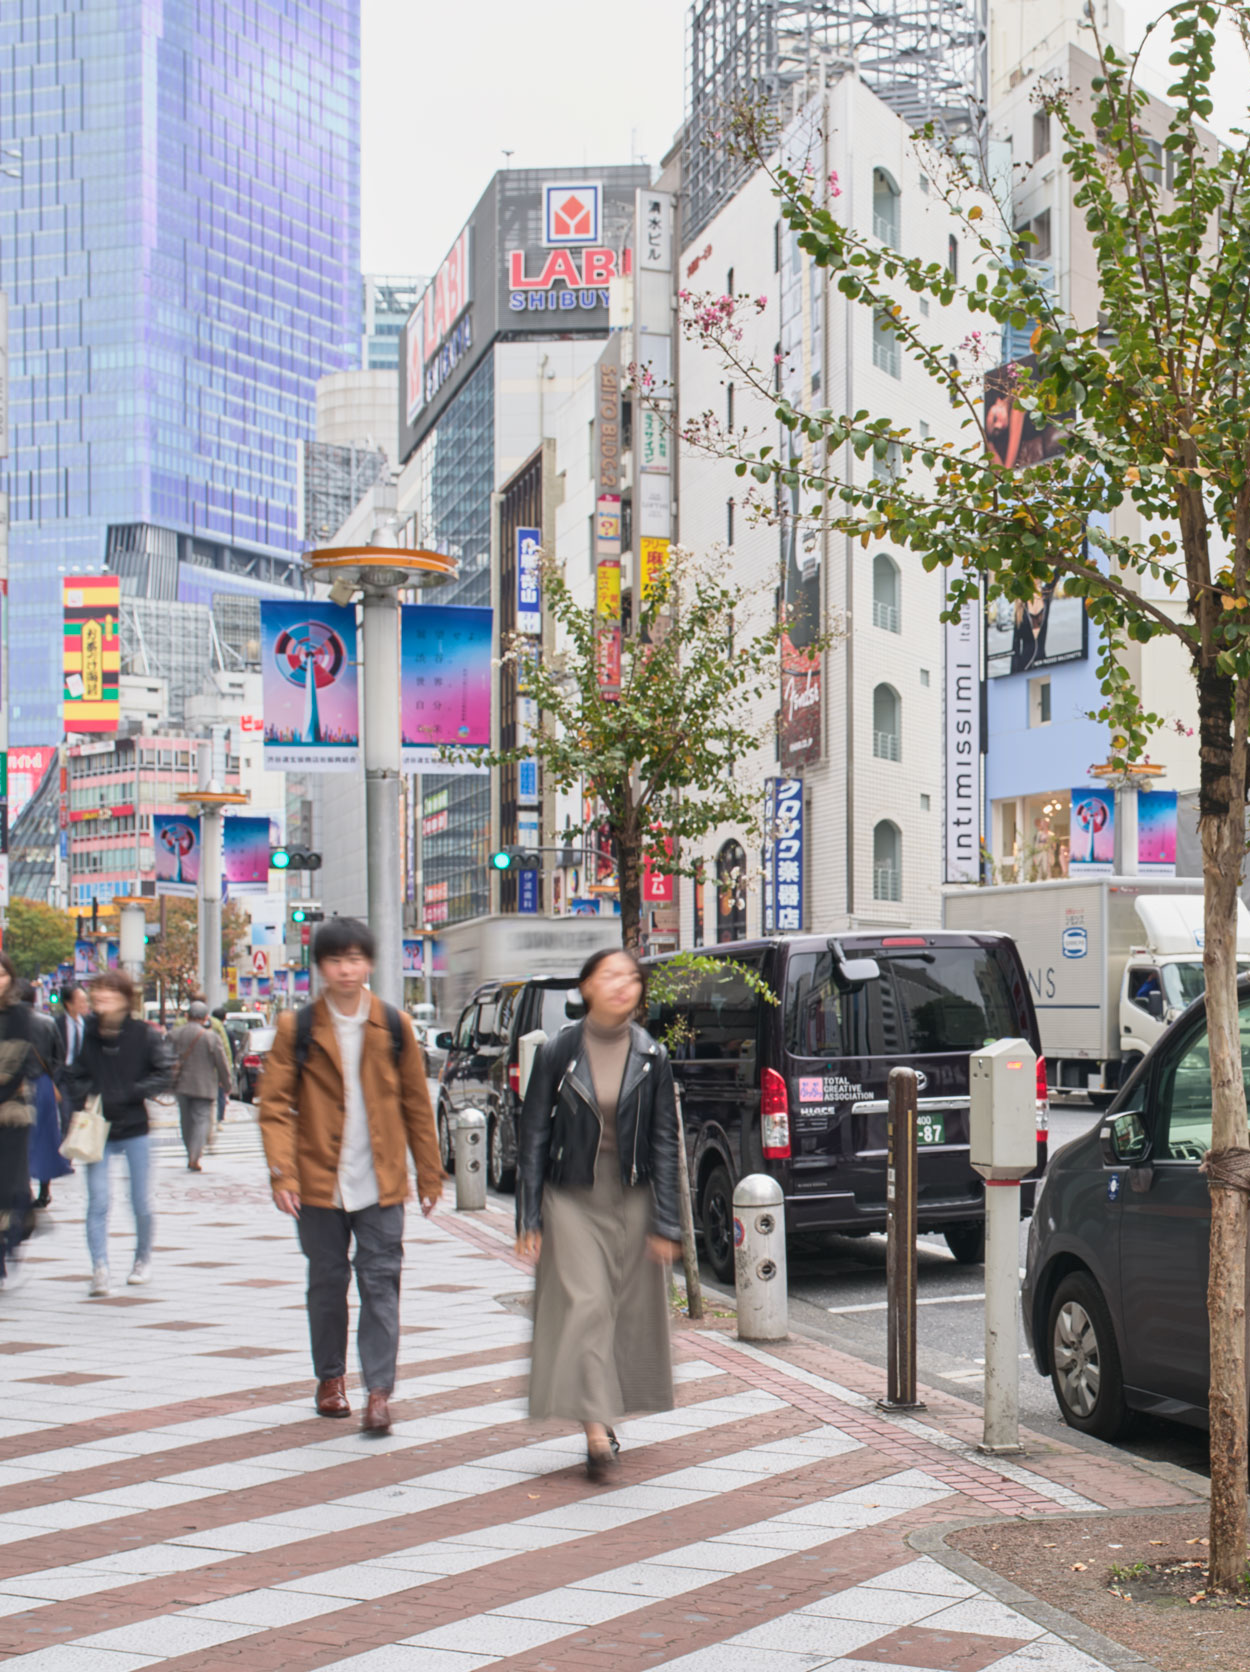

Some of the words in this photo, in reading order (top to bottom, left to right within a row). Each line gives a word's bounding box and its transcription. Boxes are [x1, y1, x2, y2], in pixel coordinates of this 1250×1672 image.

[510, 248, 632, 289] LABI
[510, 290, 610, 311] SHIBUY
[953, 664, 972, 860] intimissimi
[777, 779, 801, 930] クロサワ楽器店
[823, 1076, 850, 1085] TOTAL
[823, 1084, 862, 1093] CREATIVE
[823, 1091, 875, 1101] ASSOCIATION
[917, 1125, 942, 1143] -87
